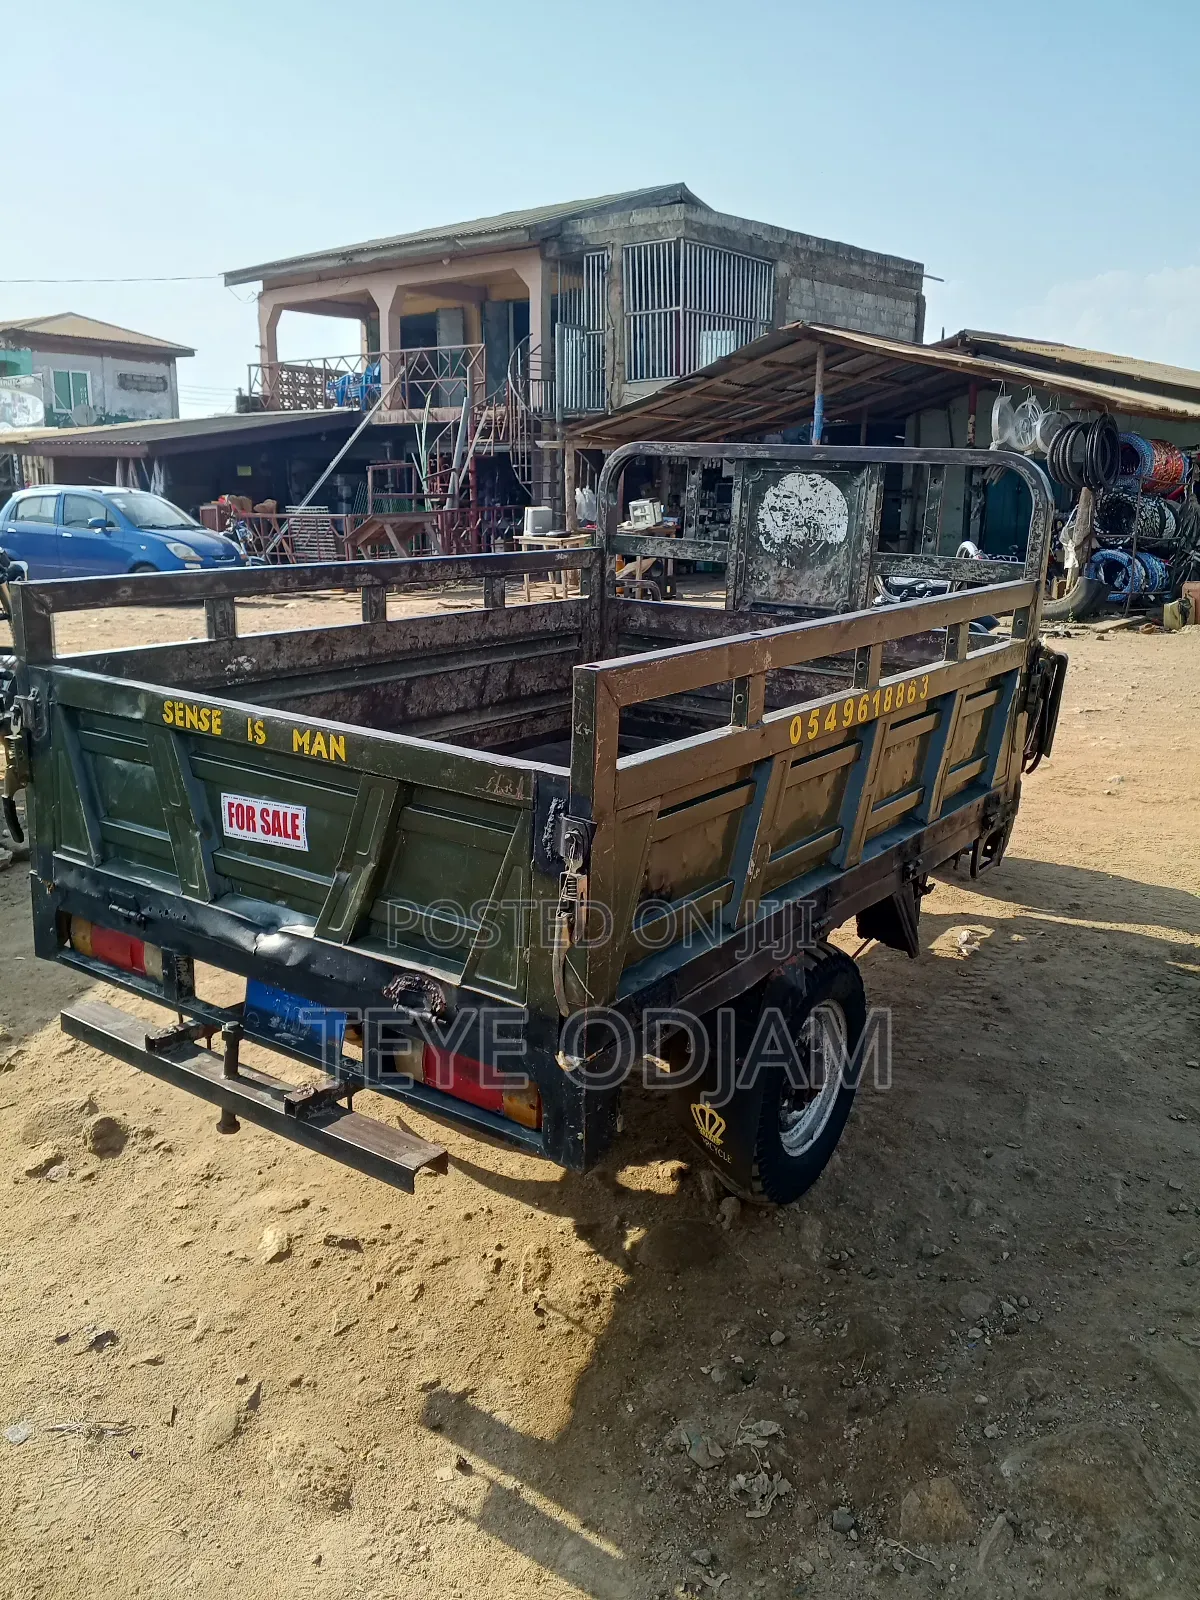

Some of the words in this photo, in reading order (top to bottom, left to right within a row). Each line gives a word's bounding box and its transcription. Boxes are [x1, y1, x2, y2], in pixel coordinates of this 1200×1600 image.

[162, 700, 223, 736] SENSE
[247, 717, 267, 745] IS
[292, 728, 347, 762] MAN
[789, 674, 929, 745] 0549618863
[227, 801, 257, 833] FOR
[260, 807, 301, 841] SALE
